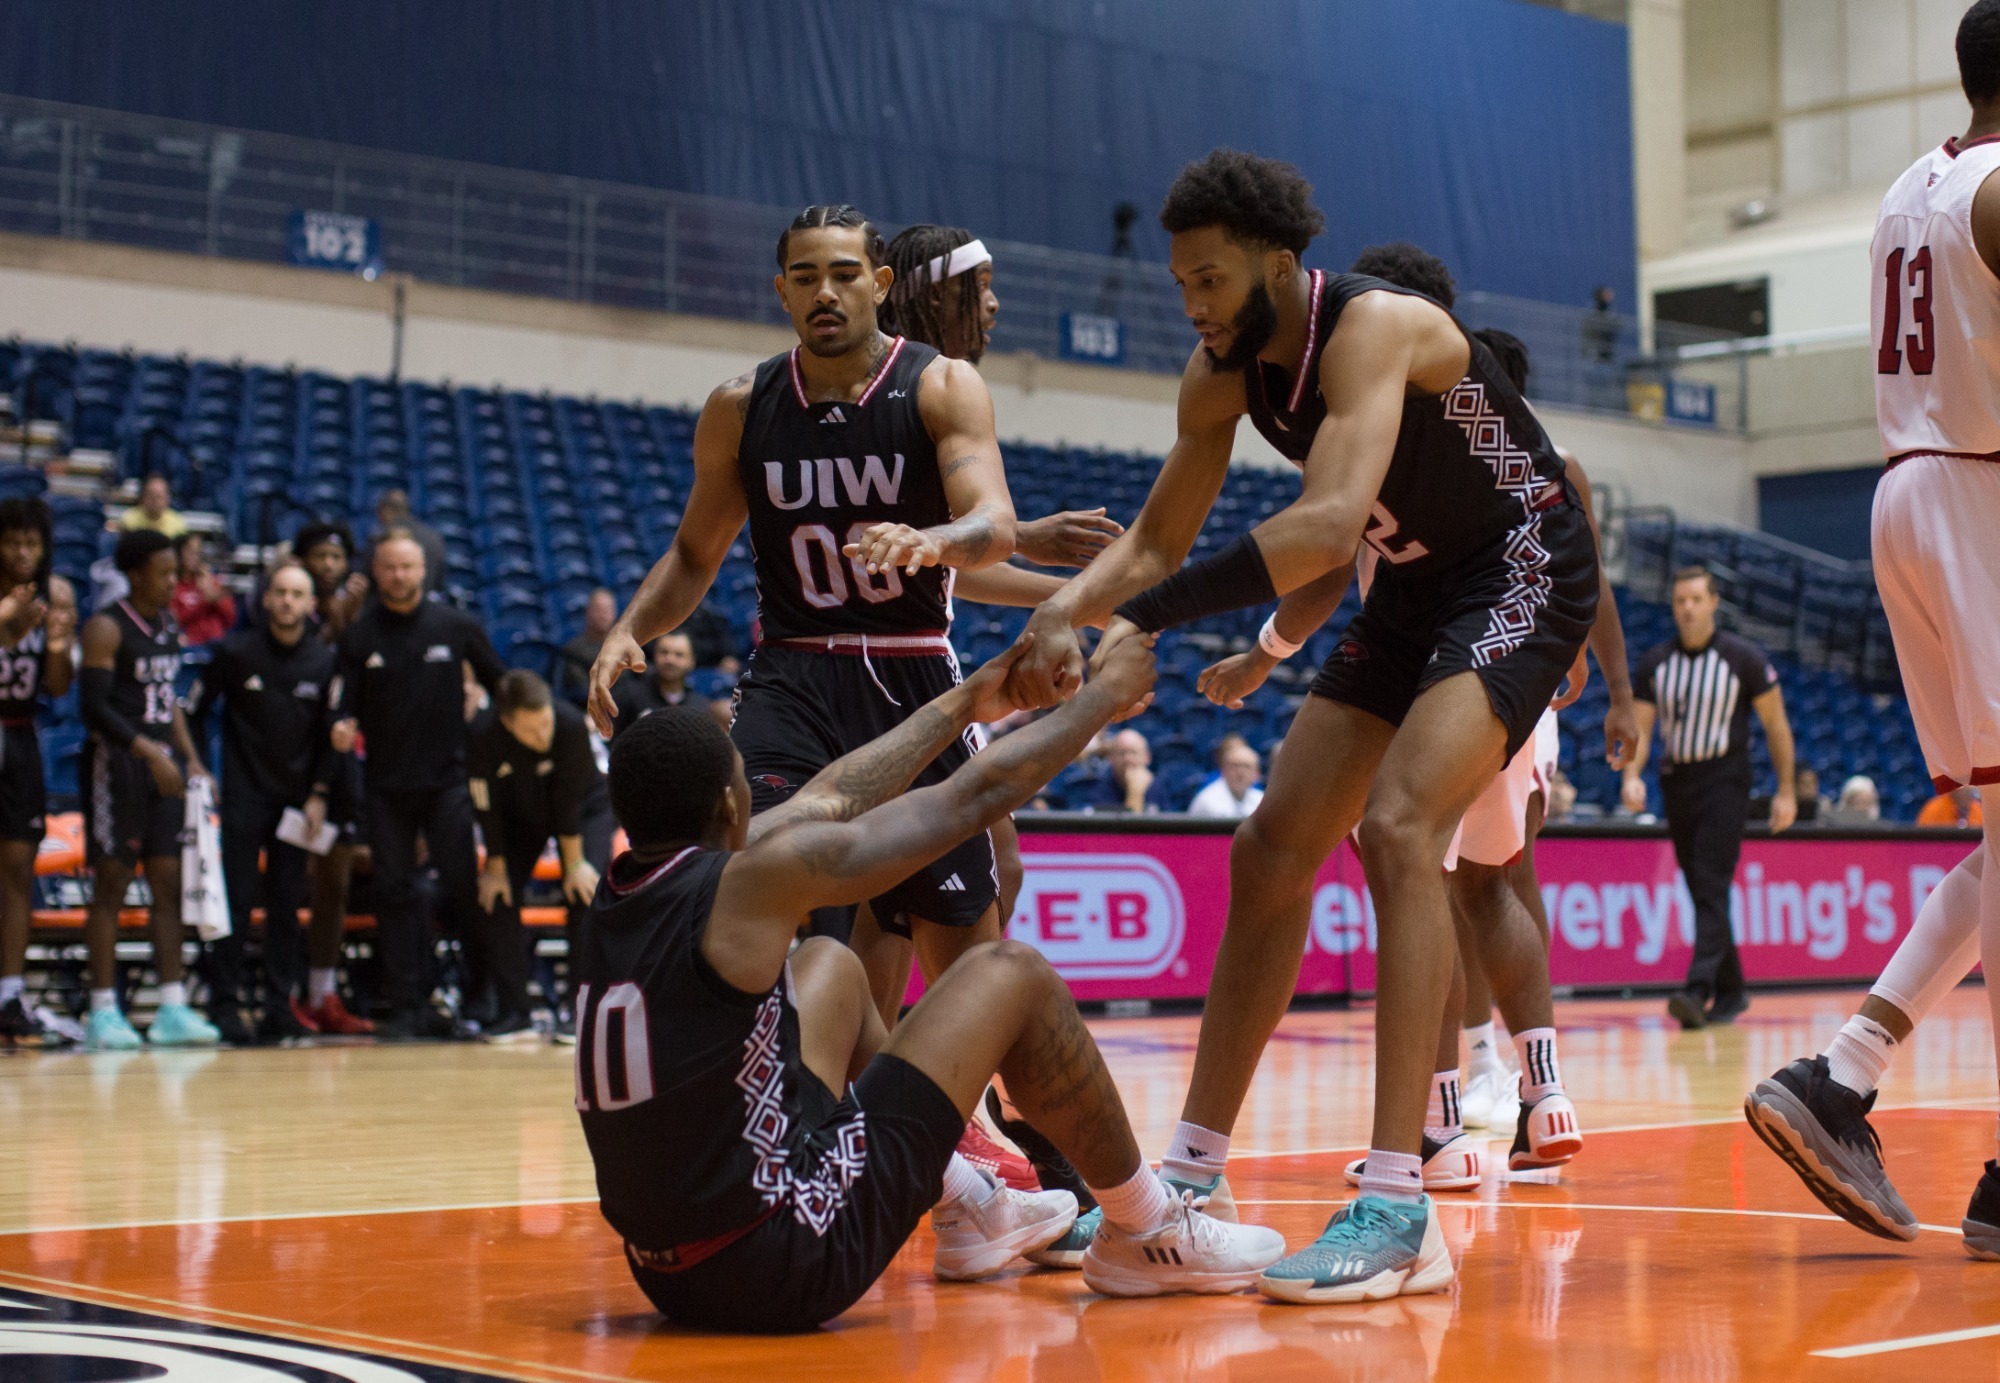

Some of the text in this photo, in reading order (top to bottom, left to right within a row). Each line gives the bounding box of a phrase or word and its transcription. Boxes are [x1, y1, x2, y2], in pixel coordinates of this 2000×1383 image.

[1878, 245, 1935, 375] 13
[763, 453, 905, 510] UIW
[1540, 861, 1897, 965] eryting's
